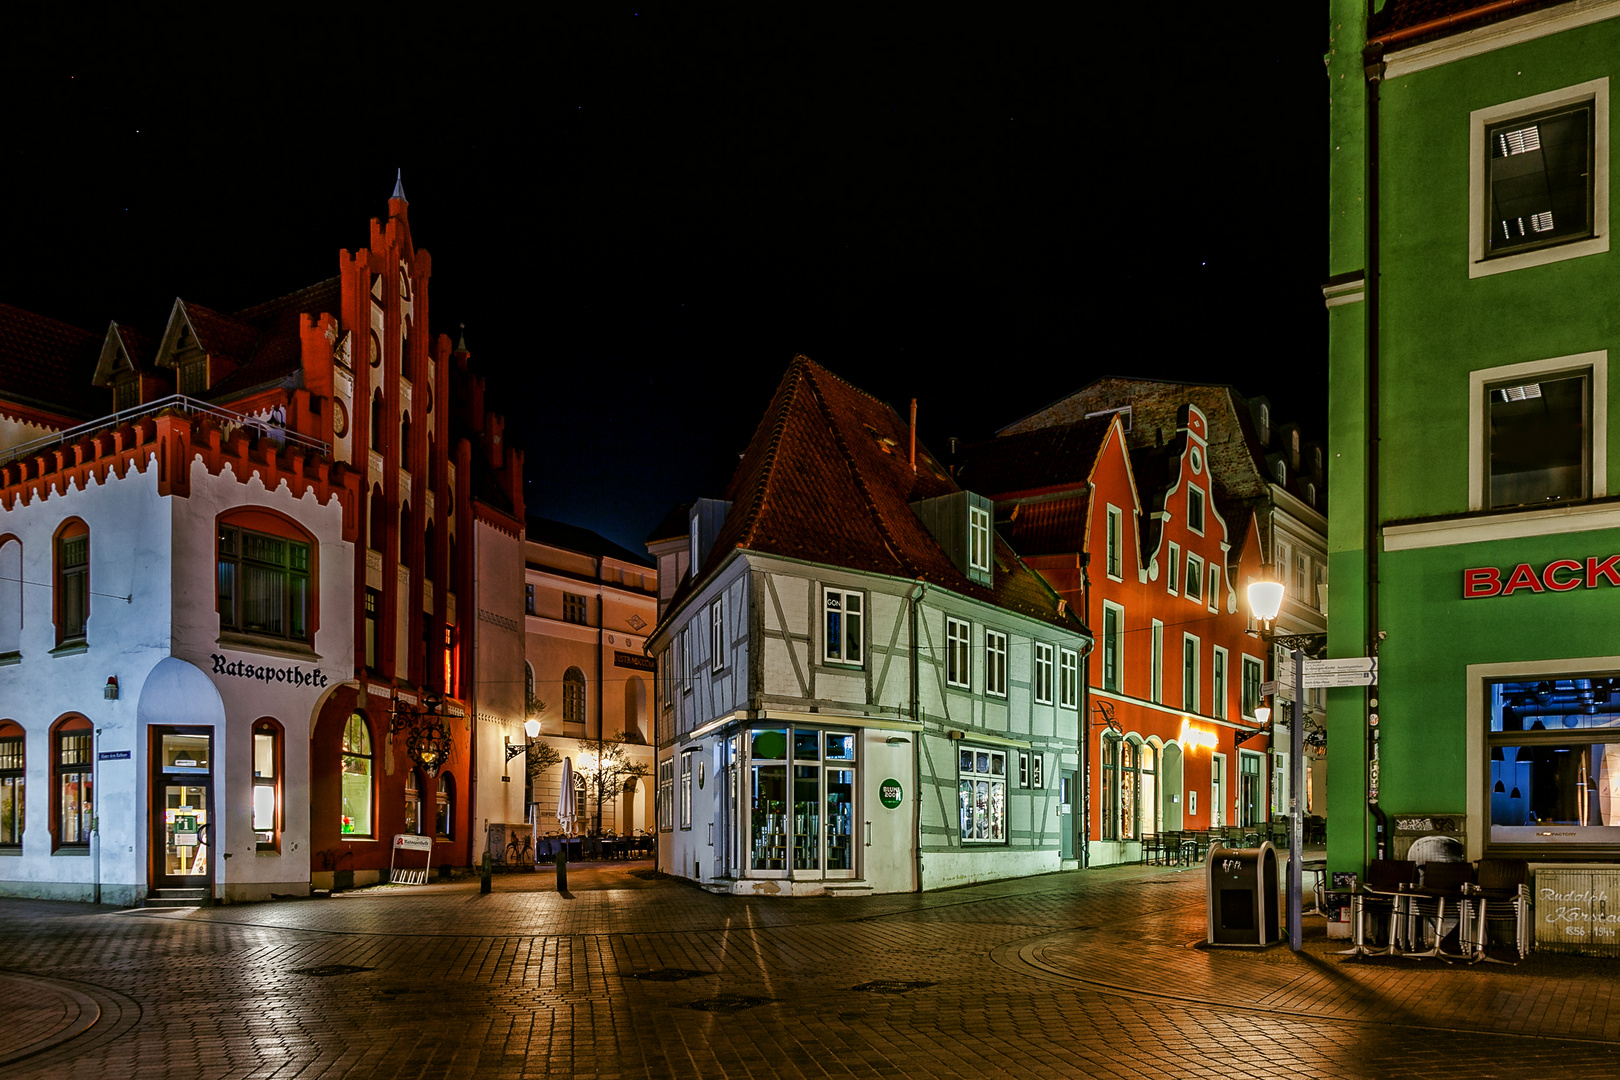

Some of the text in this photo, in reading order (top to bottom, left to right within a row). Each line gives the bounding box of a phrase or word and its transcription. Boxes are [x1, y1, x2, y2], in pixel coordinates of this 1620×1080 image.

[1464, 555, 1620, 599] BACK
[210, 653, 328, 688] Ratsapotheke
[1540, 888, 1608, 908] Rudolph
[1593, 926, 1616, 937] 1944
